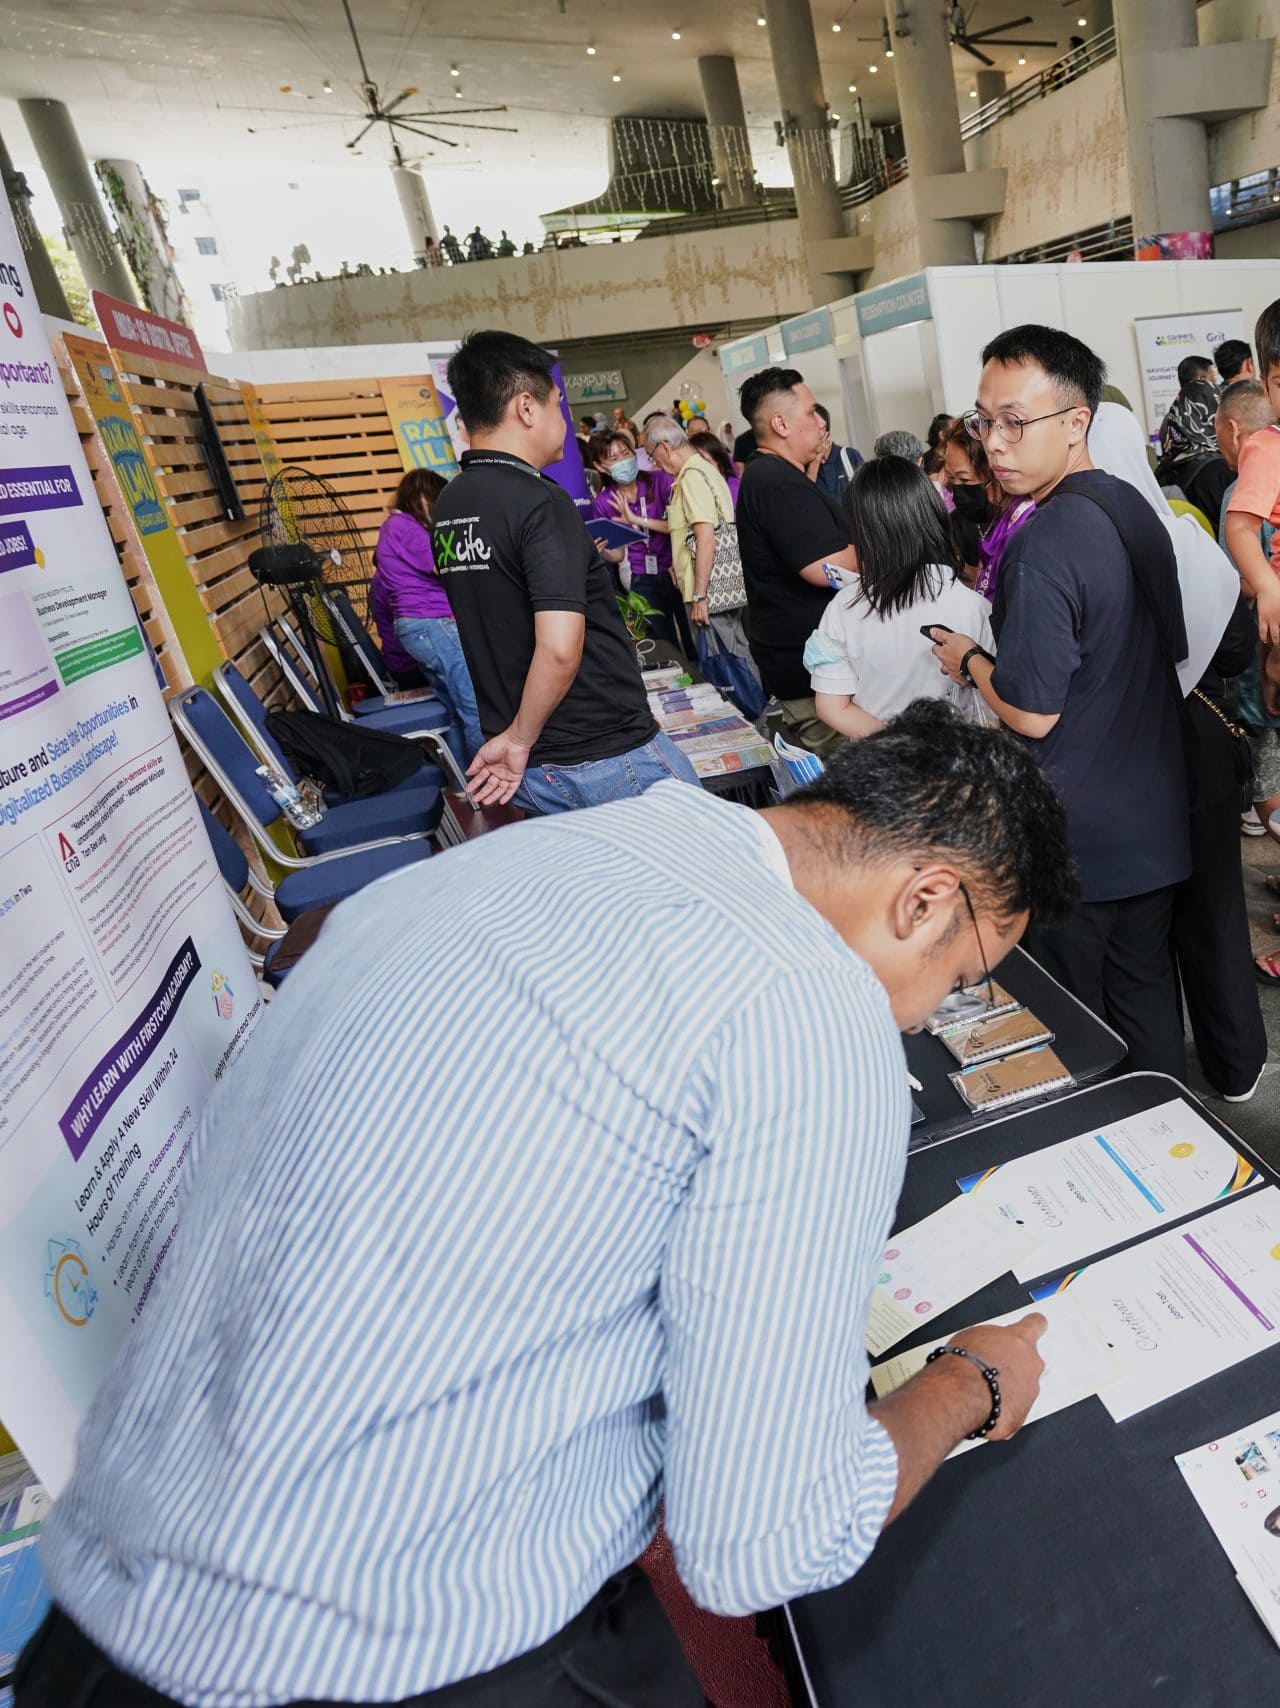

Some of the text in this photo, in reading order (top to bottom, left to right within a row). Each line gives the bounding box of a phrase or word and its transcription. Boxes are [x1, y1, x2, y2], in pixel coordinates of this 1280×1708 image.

[1206, 331, 1226, 342] Grit
[564, 374, 620, 388] KAMPUNG
[6, 480, 56, 498] ESSENTIAL
[55, 478, 73, 493] FOR
[4, 535, 28, 554] JOBS!
[55, 595, 87, 609] Development
[87, 590, 106, 600] Manager
[28, 747, 49, 771] and
[46, 738, 70, 760] Seize
[77, 702, 129, 739] Opportunities
[128, 695, 138, 709] in
[50, 760, 85, 790] Business
[65, 853, 80, 873] cna
[71, 952, 192, 1137] WHY LEARN WITH FIRSTCOM ACADEMY?
[75, 1048, 178, 1211] Learn & Apply A New Skill Within 24
[149, 1132, 176, 1173] Classroom
[174, 1106, 191, 1133] Training
[86, 1144, 141, 1236] Hours Of Training
[138, 1214, 149, 1232] and
[144, 1182, 167, 1216] interact
[166, 1166, 177, 1184] with
[1027, 1186, 1062, 1227] Certificate
[1066, 1181, 1087, 1203] John Tan
[138, 1227, 156, 1258] proven
[154, 1196, 174, 1228] training
[135, 1270, 155, 1316] Localised
[153, 1236, 172, 1272] syllabus
[1112, 1299, 1158, 1350] Certificate
[1156, 1291, 1183, 1319] John Tan
